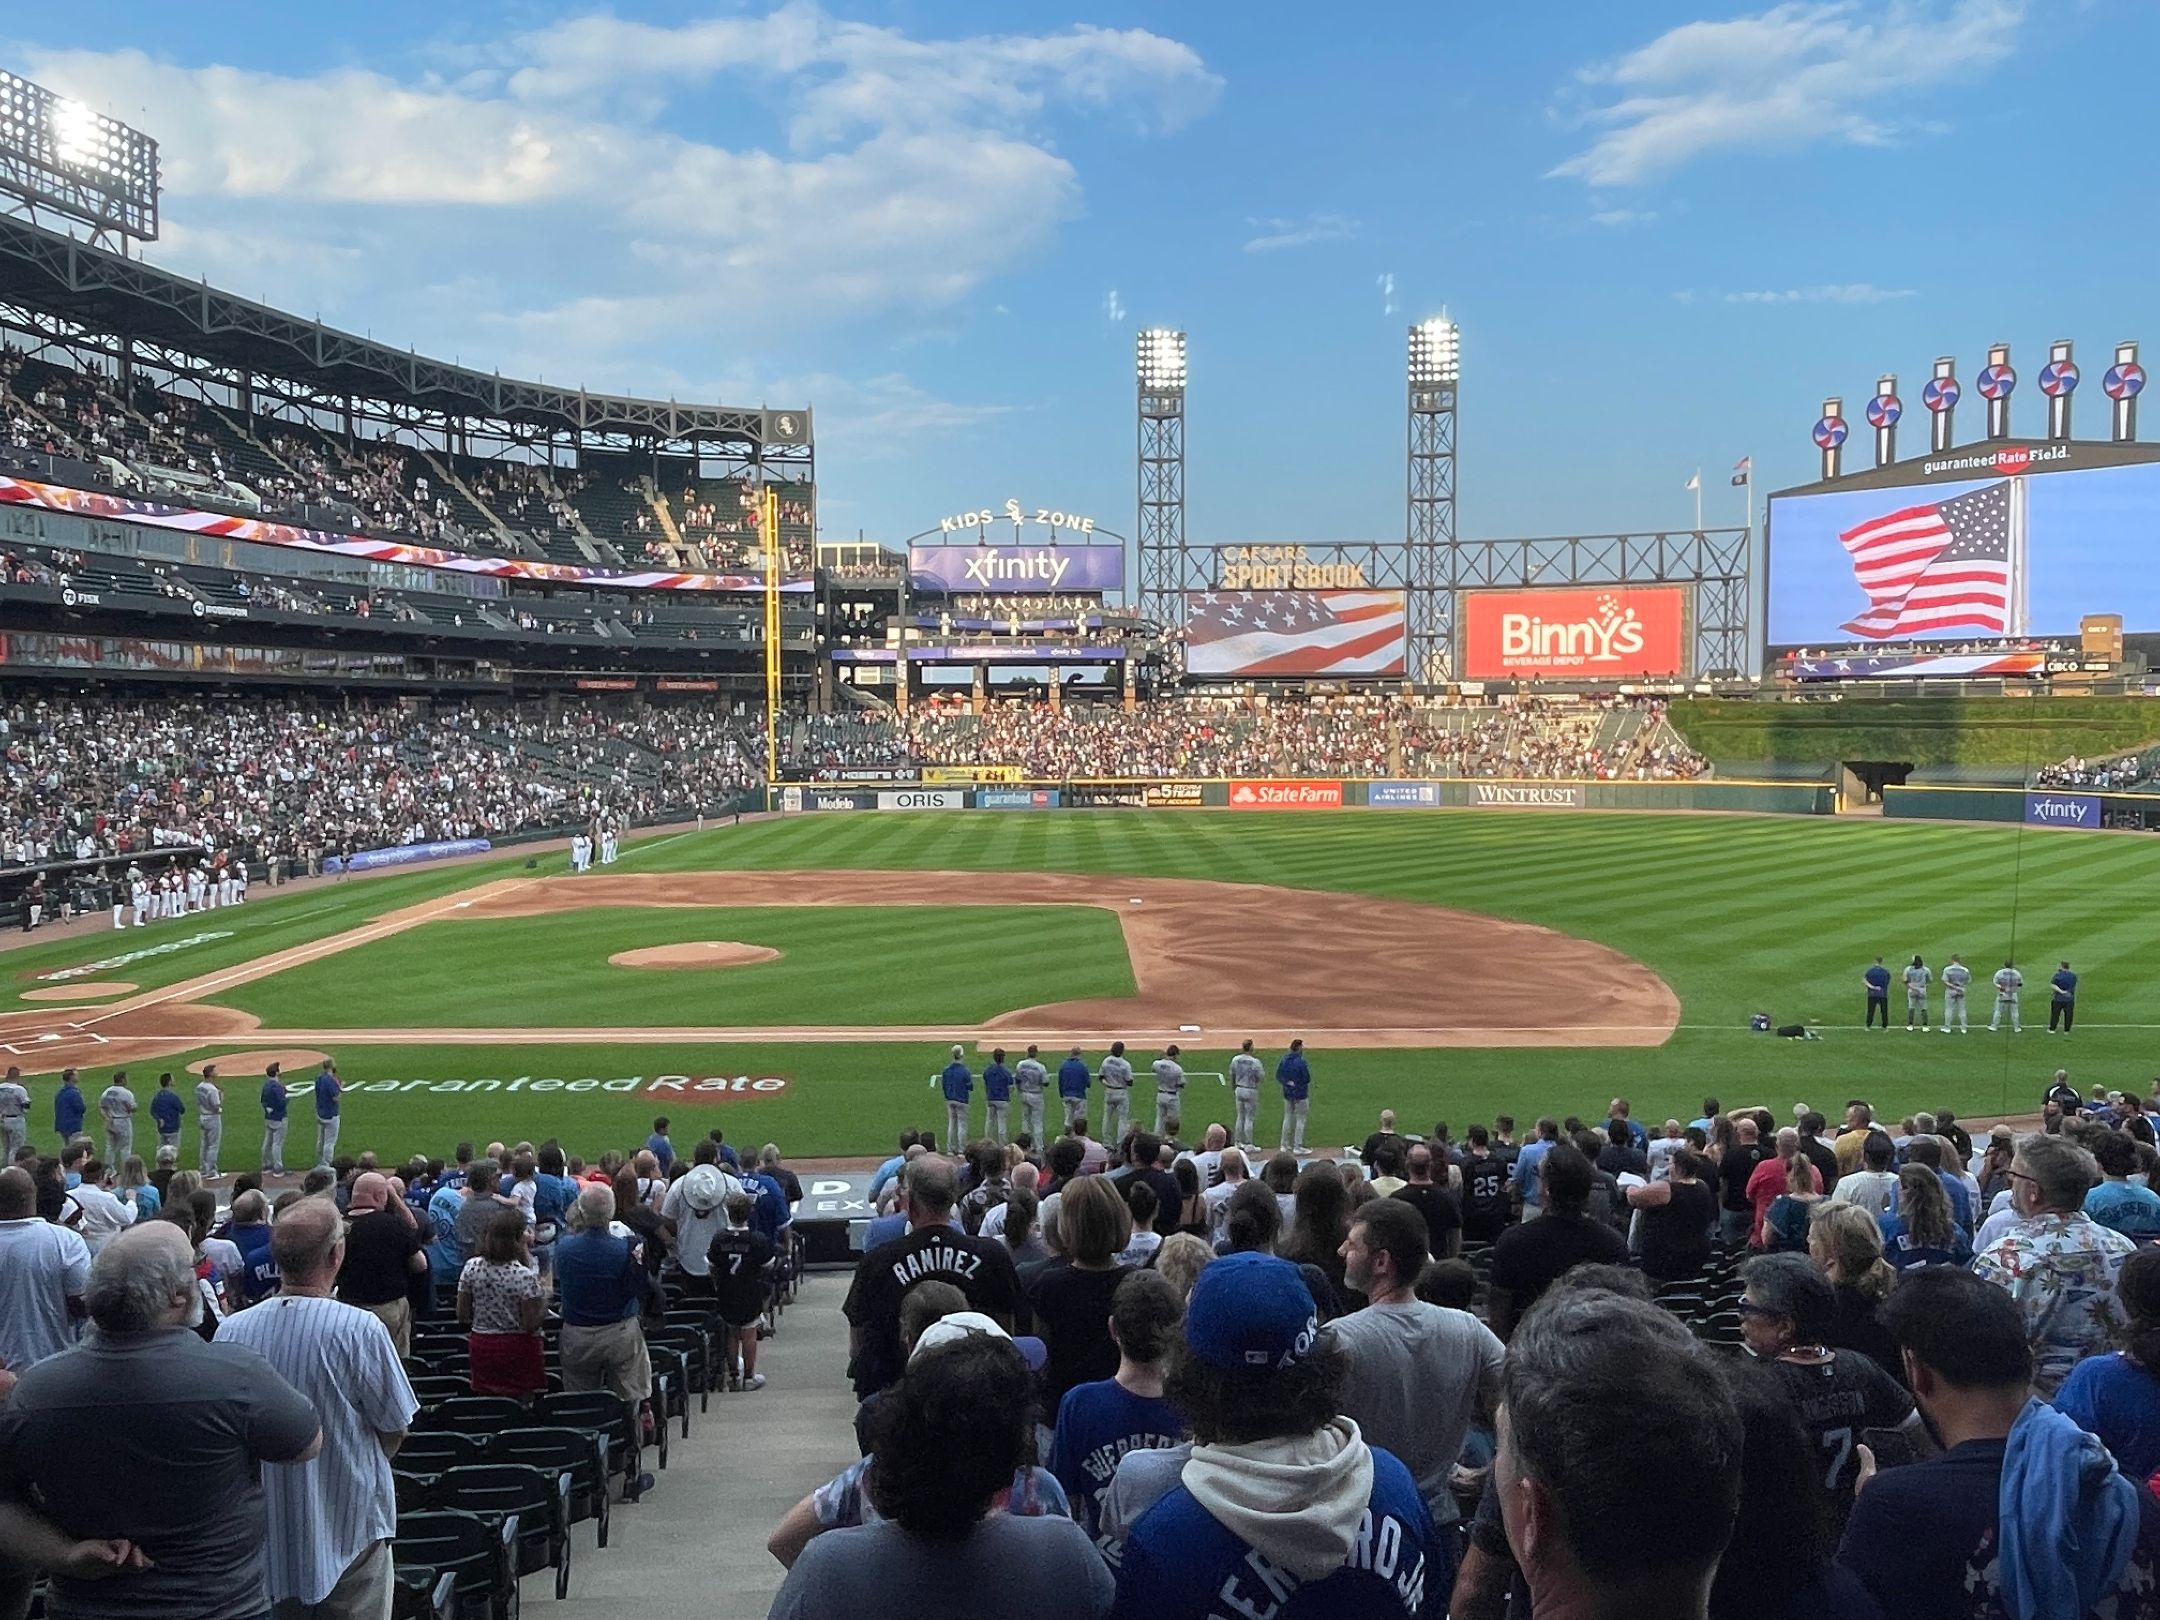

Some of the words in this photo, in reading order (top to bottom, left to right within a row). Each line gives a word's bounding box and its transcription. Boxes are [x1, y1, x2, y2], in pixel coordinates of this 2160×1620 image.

[1924, 453, 1997, 475] guaranteed
[1998, 450, 2027, 465] Rate
[2028, 445, 2068, 462] Field
[941, 509, 994, 533] KIDS
[1035, 509, 1095, 533] ZONE
[1224, 546, 1307, 561] CAESARS
[964, 549, 1070, 587] xfinity
[1223, 564, 1365, 589] SPORTSBOOK
[1503, 656, 1551, 667] BEVERAGE
[1553, 655, 1585, 666] DEPOT
[897, 793, 944, 807] ORIS
[984, 792, 1031, 807] guaranteed
[1161, 784, 1172, 798] 5
[1477, 785, 1576, 802] WINTRUST
[817, 796, 854, 810] Modelo
[2034, 798, 2087, 823] xfinity
[647, 1075, 787, 1092] Rate
[1473, 1175, 1499, 1197] 25
[728, 1253, 743, 1275] 7
[892, 1246, 982, 1287] RAMIREZ
[1822, 1426, 1852, 1490] 7
